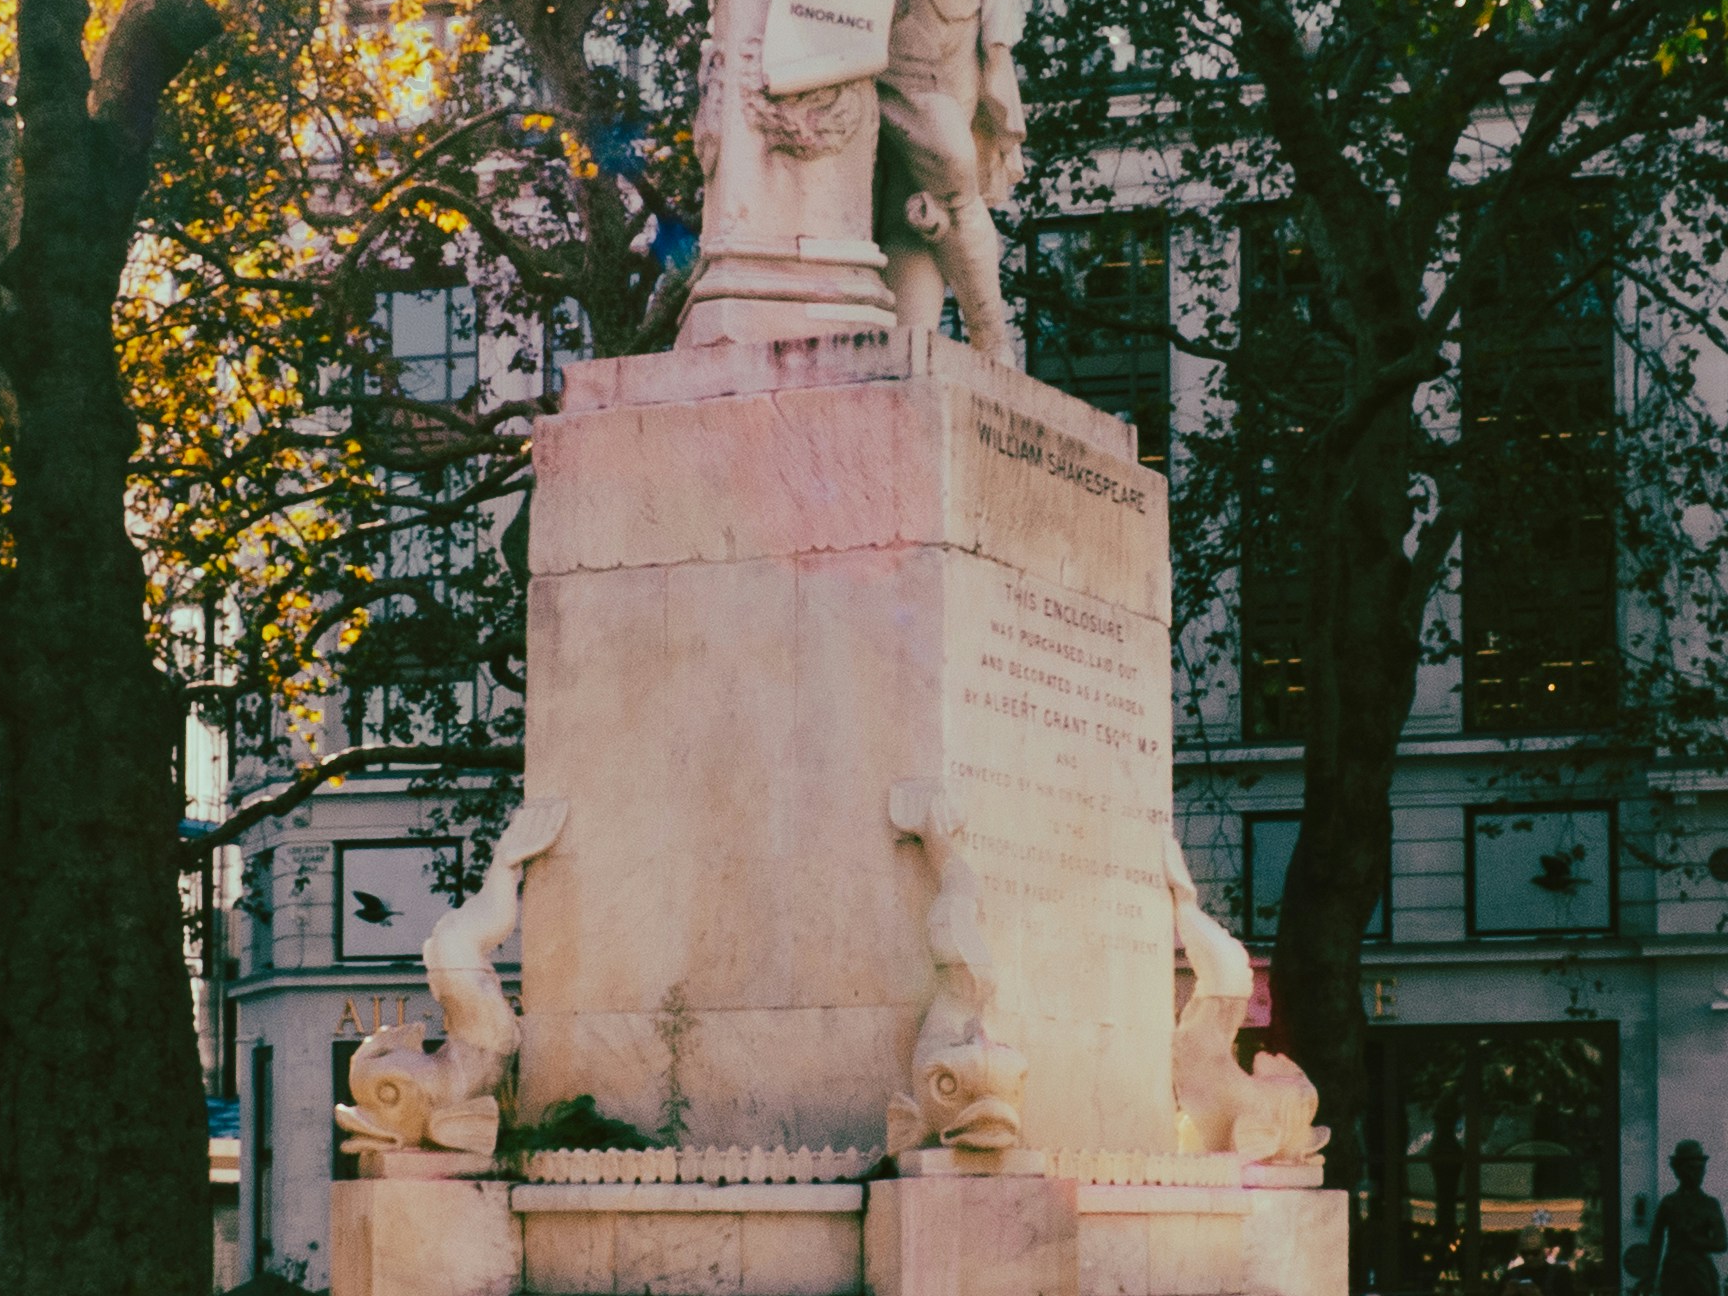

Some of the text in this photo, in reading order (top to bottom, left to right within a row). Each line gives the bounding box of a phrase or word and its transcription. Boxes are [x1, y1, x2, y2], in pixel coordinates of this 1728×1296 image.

[790, 3, 873, 32] IGNORANCE
[976, 418, 1043, 470] WILLIAM
[1047, 451, 1147, 516] SHAKESPEARE
[1004, 582, 1125, 645] THIS ENCLOSURE
[980, 652, 1004, 673] AND
[1008, 659, 1072, 695] DECORATED
[1117, 661, 1139, 681] OUT
[963, 687, 979, 706] BY
[983, 691, 1038, 723] ALBERT
[1043, 707, 1089, 737] GRANT
